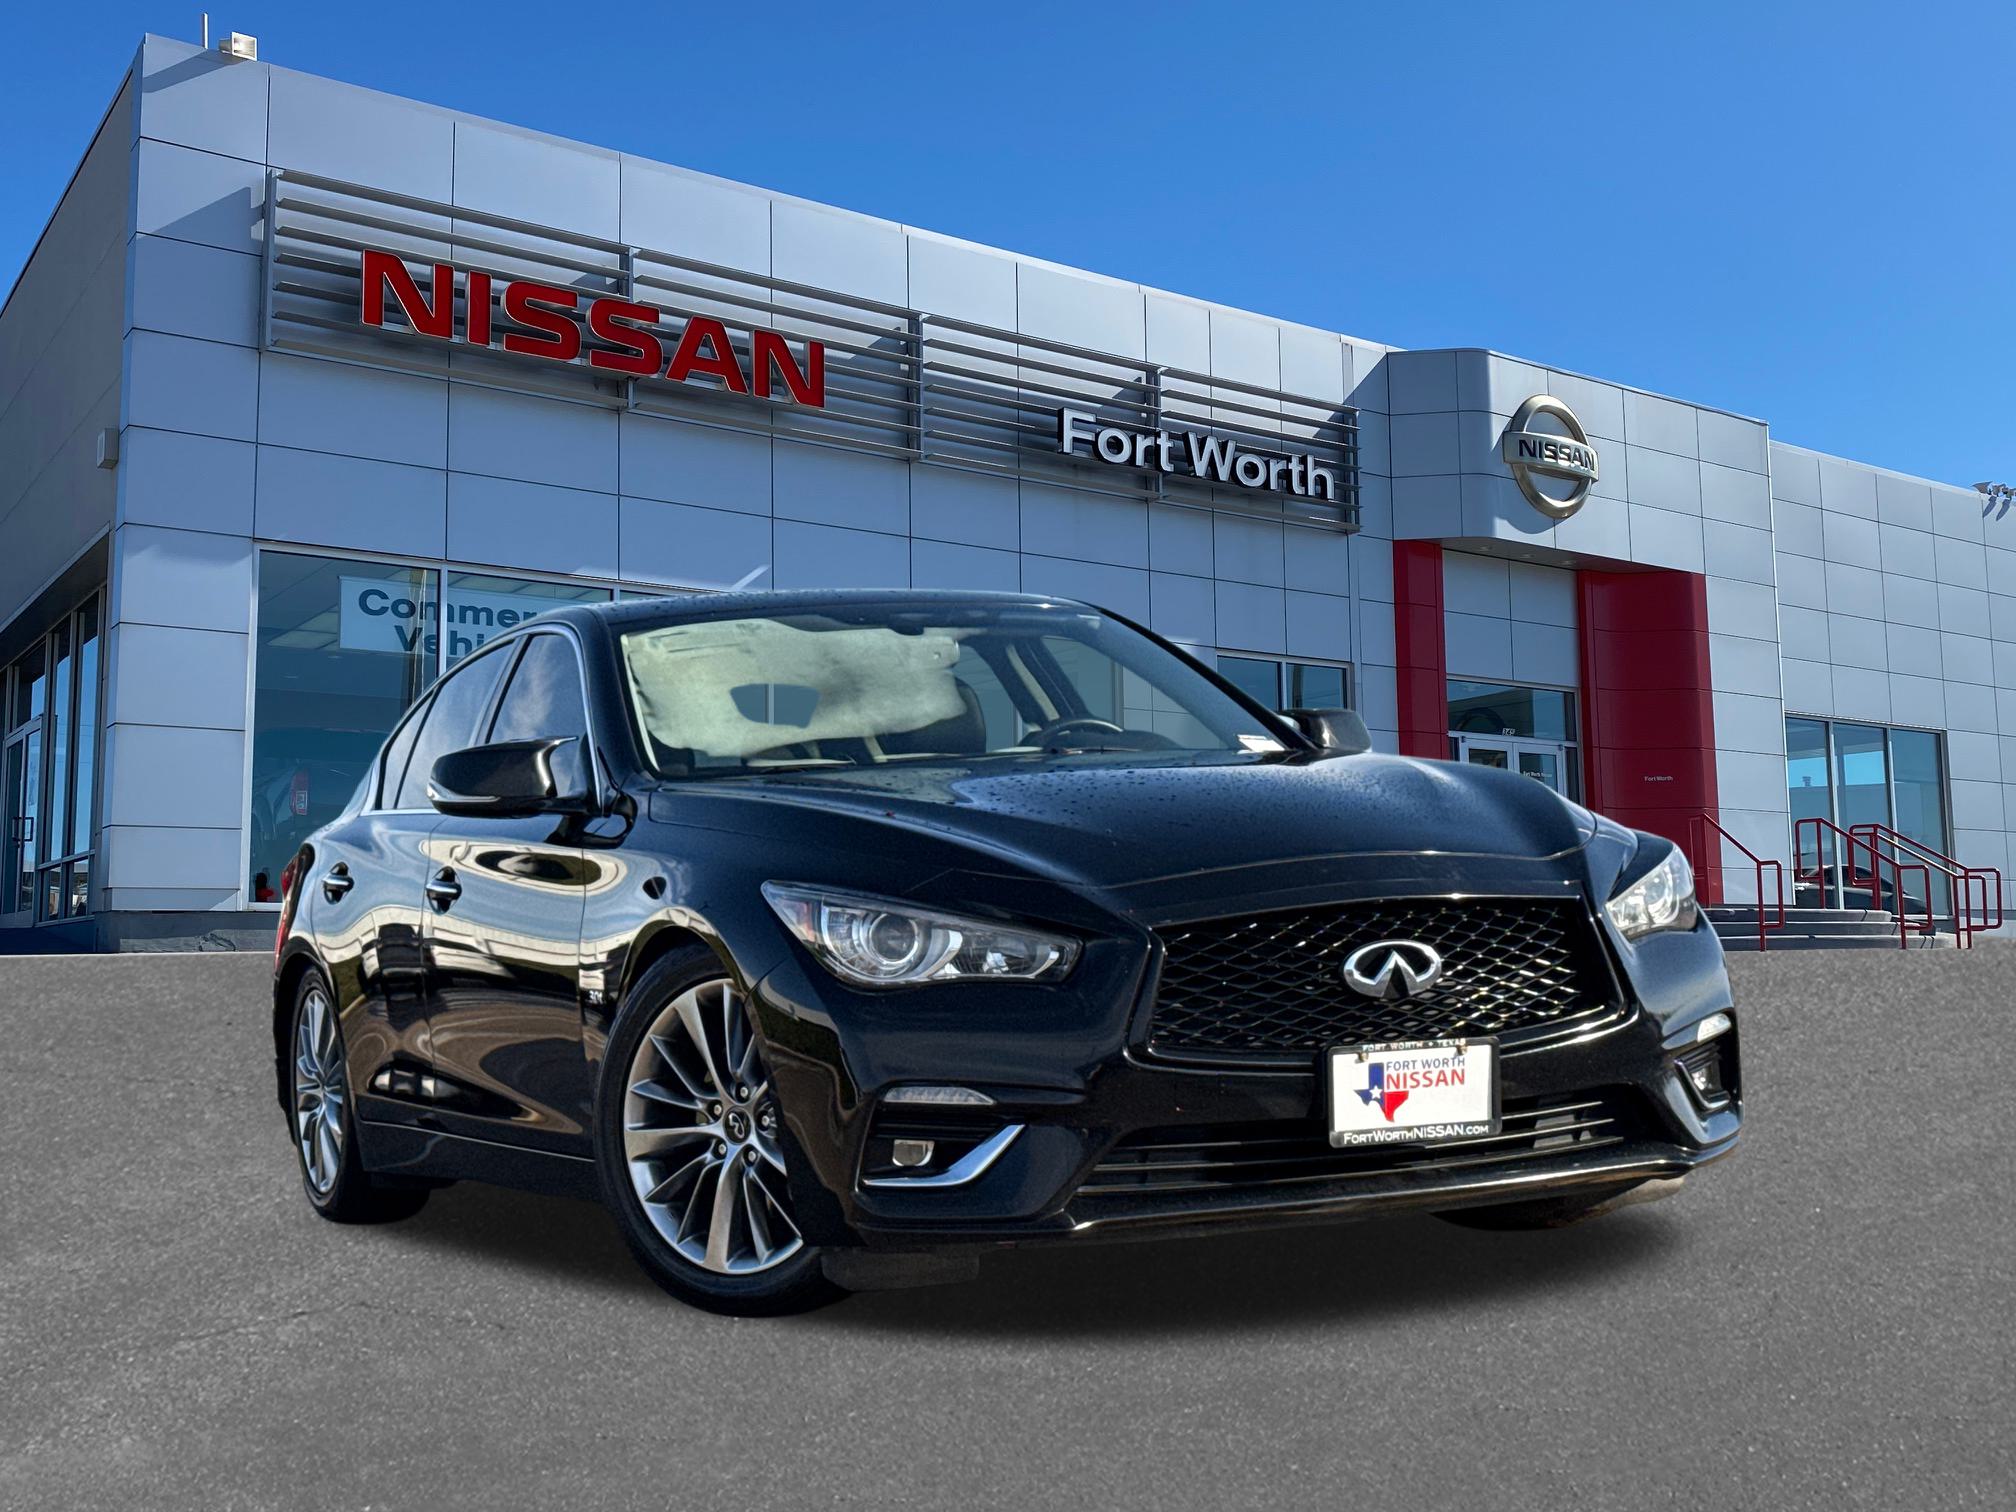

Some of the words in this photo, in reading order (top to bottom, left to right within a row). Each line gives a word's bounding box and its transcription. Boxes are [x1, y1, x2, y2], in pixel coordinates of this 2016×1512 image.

[361, 249, 825, 409] NISSAN
[1060, 407, 1175, 472] Fort
[1183, 430, 1335, 500] Worth
[1518, 439, 1595, 472] NISSAN
[1362, 1044, 1387, 1052] FORT
[1390, 1041, 1424, 1050] WORTH
[1386, 1060, 1418, 1071] FORT
[1421, 1057, 1465, 1070] WORTH
[1386, 1068, 1465, 1090] NISSAN
